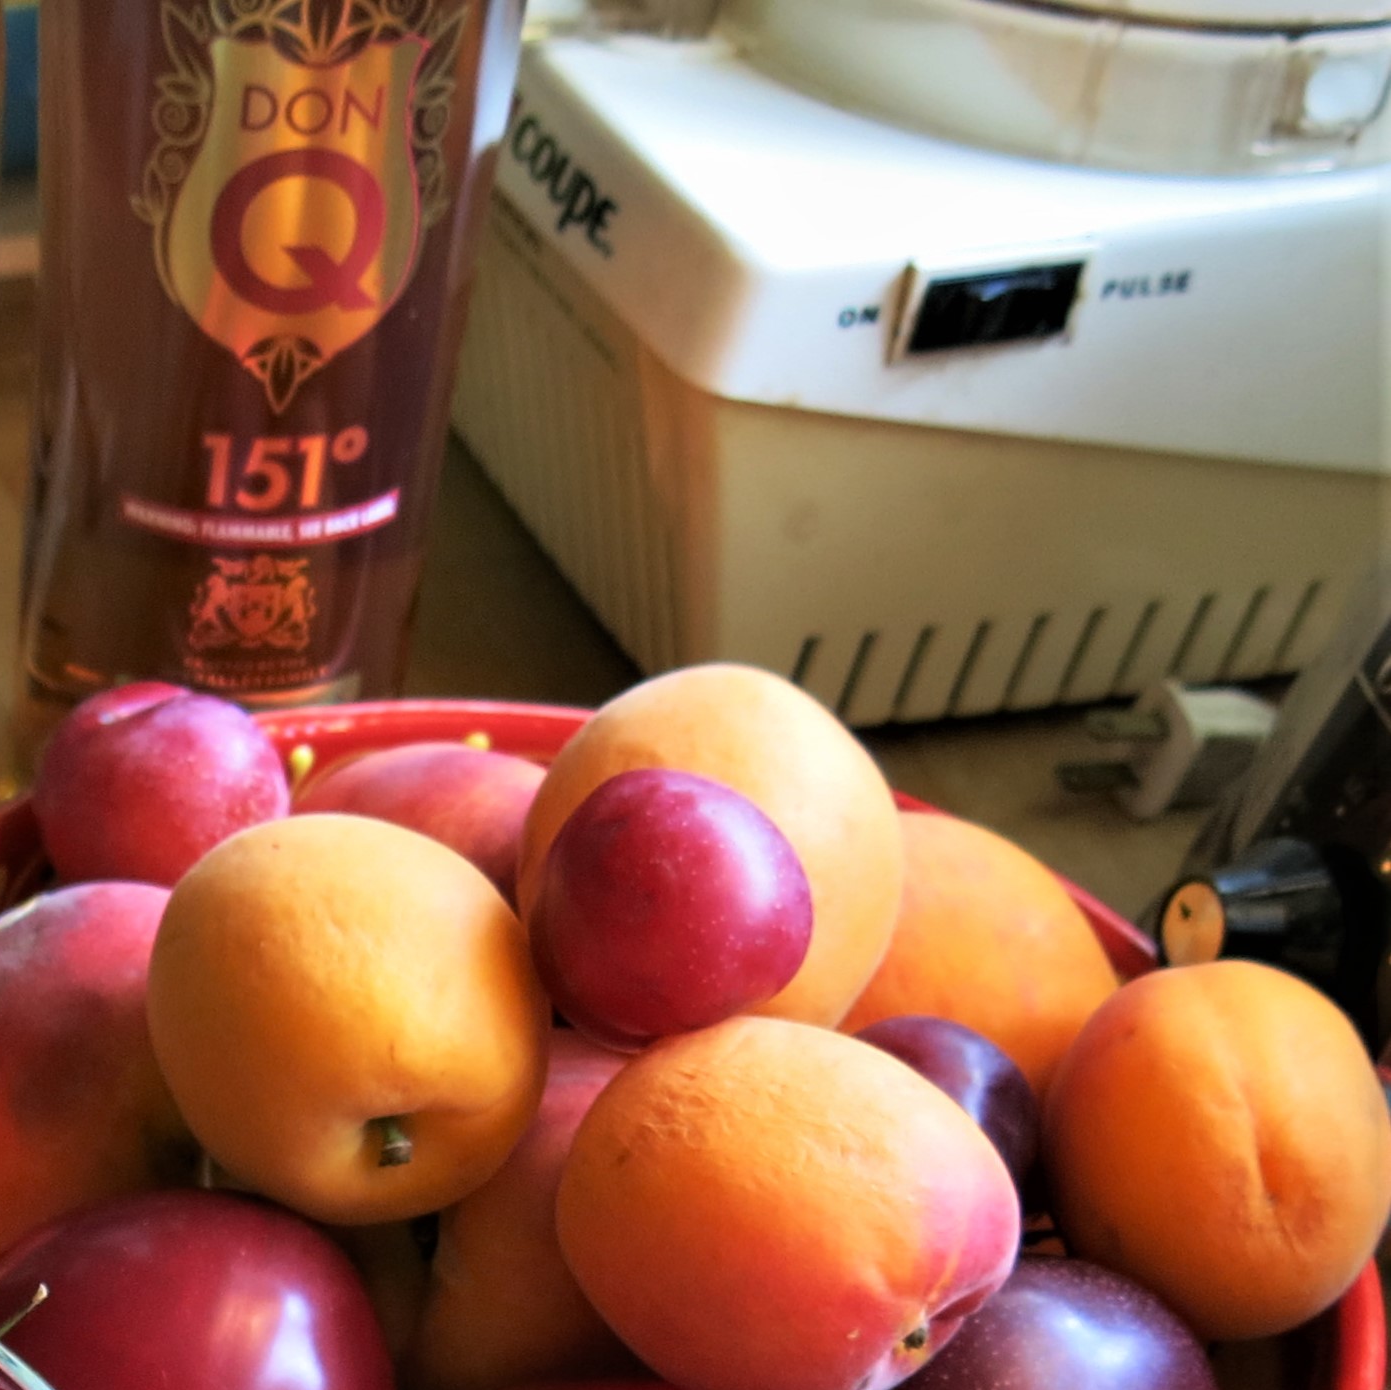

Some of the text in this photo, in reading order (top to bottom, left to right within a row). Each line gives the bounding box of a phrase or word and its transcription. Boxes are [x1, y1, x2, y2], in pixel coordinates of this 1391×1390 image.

[240, 84, 385, 136] DON
[210, 147, 388, 316] Q
[1101, 270, 1191, 298] PULSE
[838, 306, 880, 328] ON
